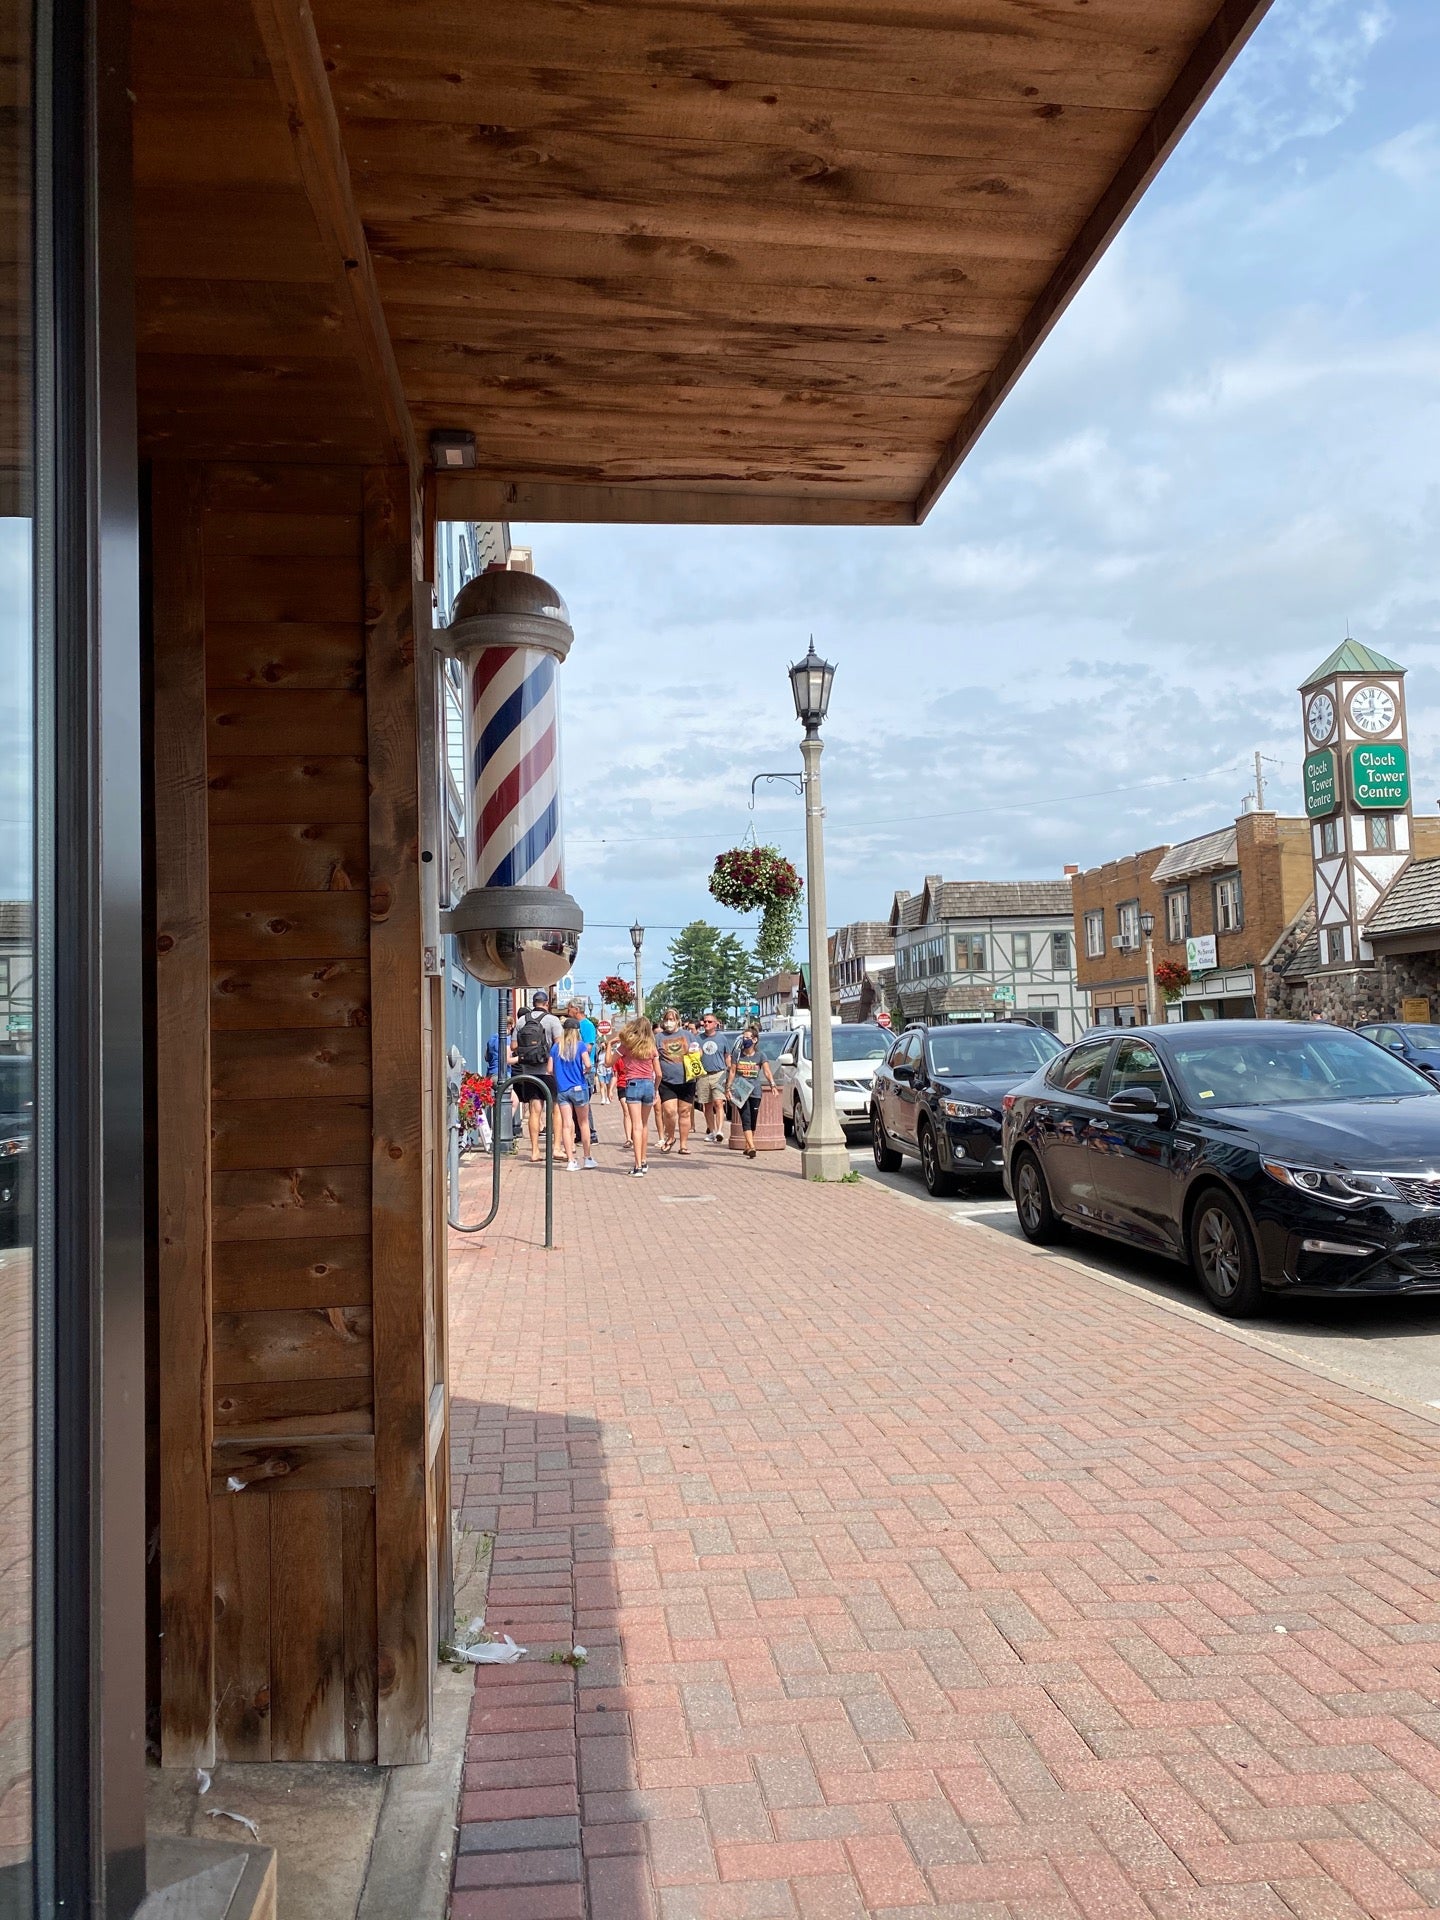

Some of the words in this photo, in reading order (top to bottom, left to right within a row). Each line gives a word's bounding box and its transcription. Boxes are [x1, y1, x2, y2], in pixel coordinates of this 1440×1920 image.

[1360, 752, 1396, 766] Clock
[1308, 760, 1328, 778] Clock
[1366, 769, 1405, 783] Tower
[1312, 777, 1333, 793] Tower
[1358, 784, 1402, 798] Centre
[1308, 793, 1331, 809] Centre
